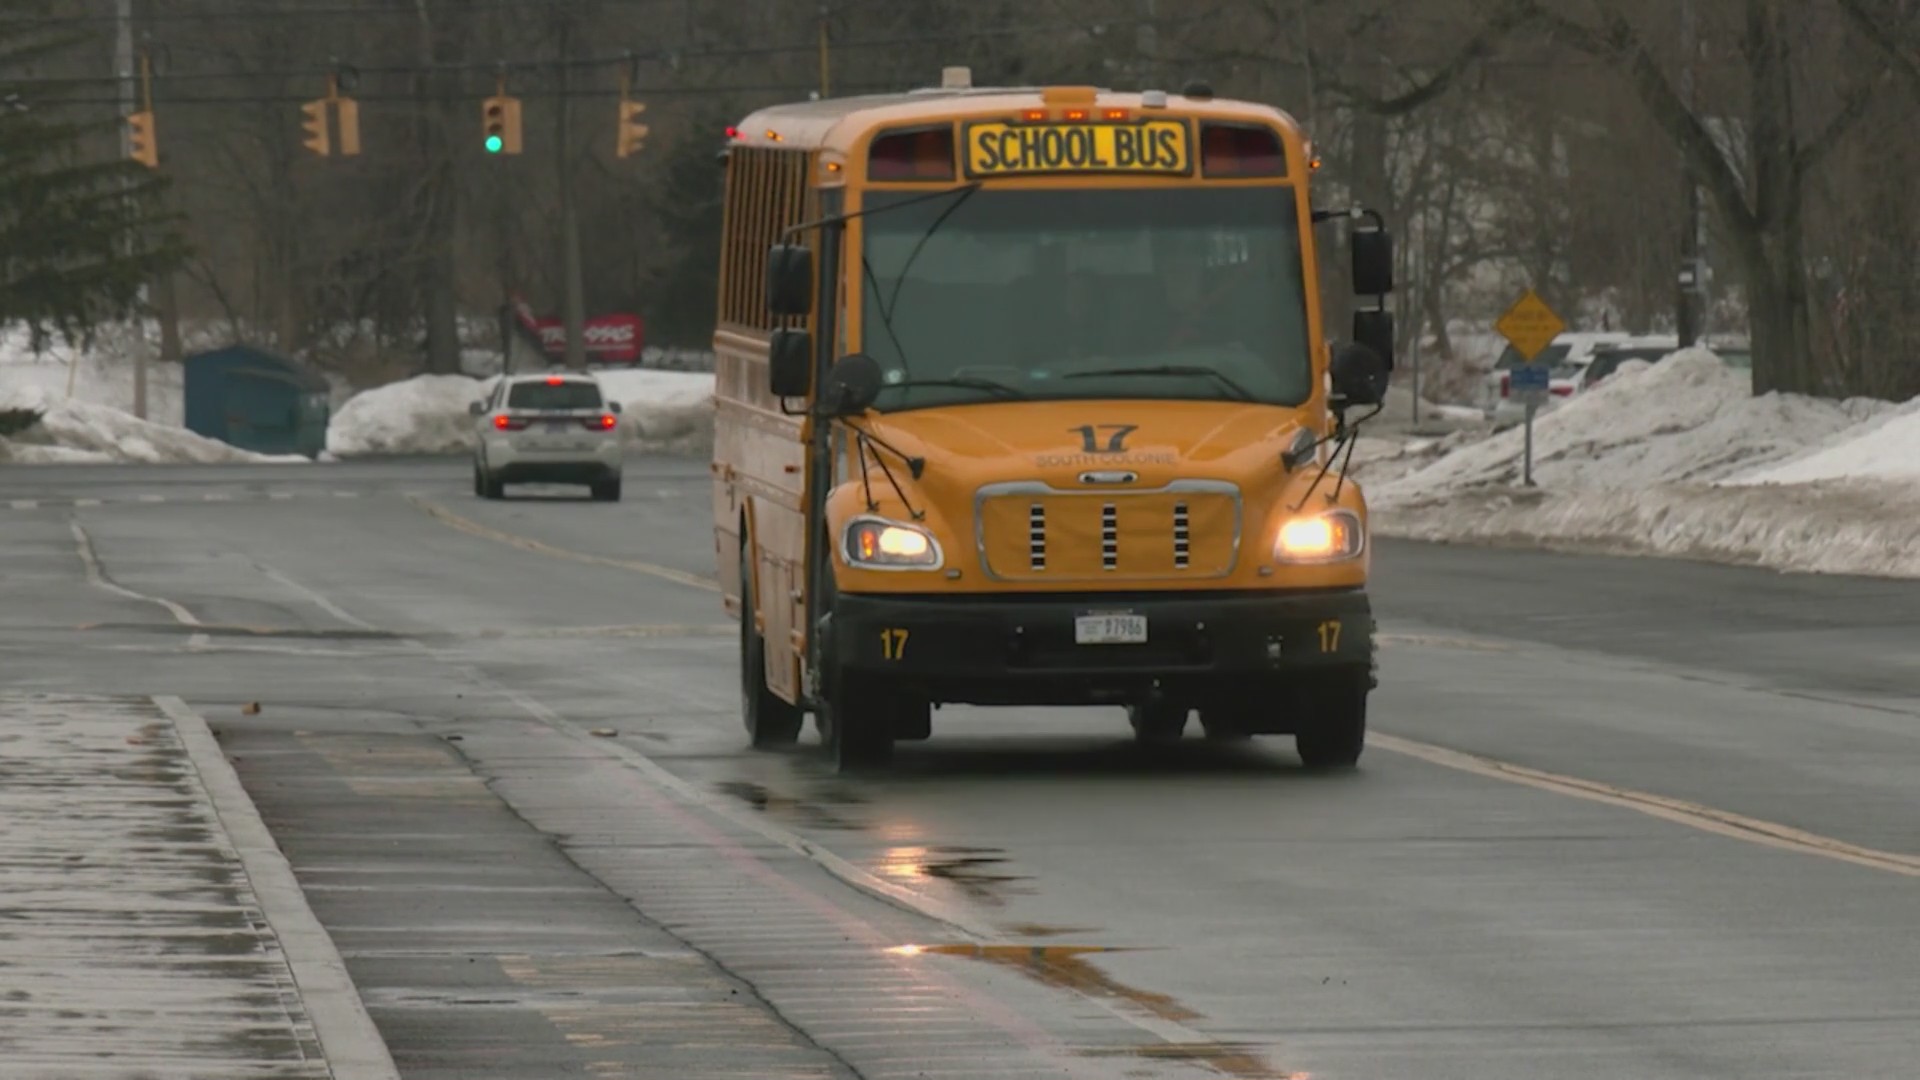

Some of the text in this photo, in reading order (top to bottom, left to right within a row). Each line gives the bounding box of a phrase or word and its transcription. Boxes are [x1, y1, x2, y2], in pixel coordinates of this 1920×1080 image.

[978, 127, 1179, 169] SCHOOL BUS
[1067, 424, 1139, 453] 17
[1035, 451, 1177, 468] SOUTH COLONIE
[881, 628, 909, 660] 17
[1318, 620, 1341, 653] 17
